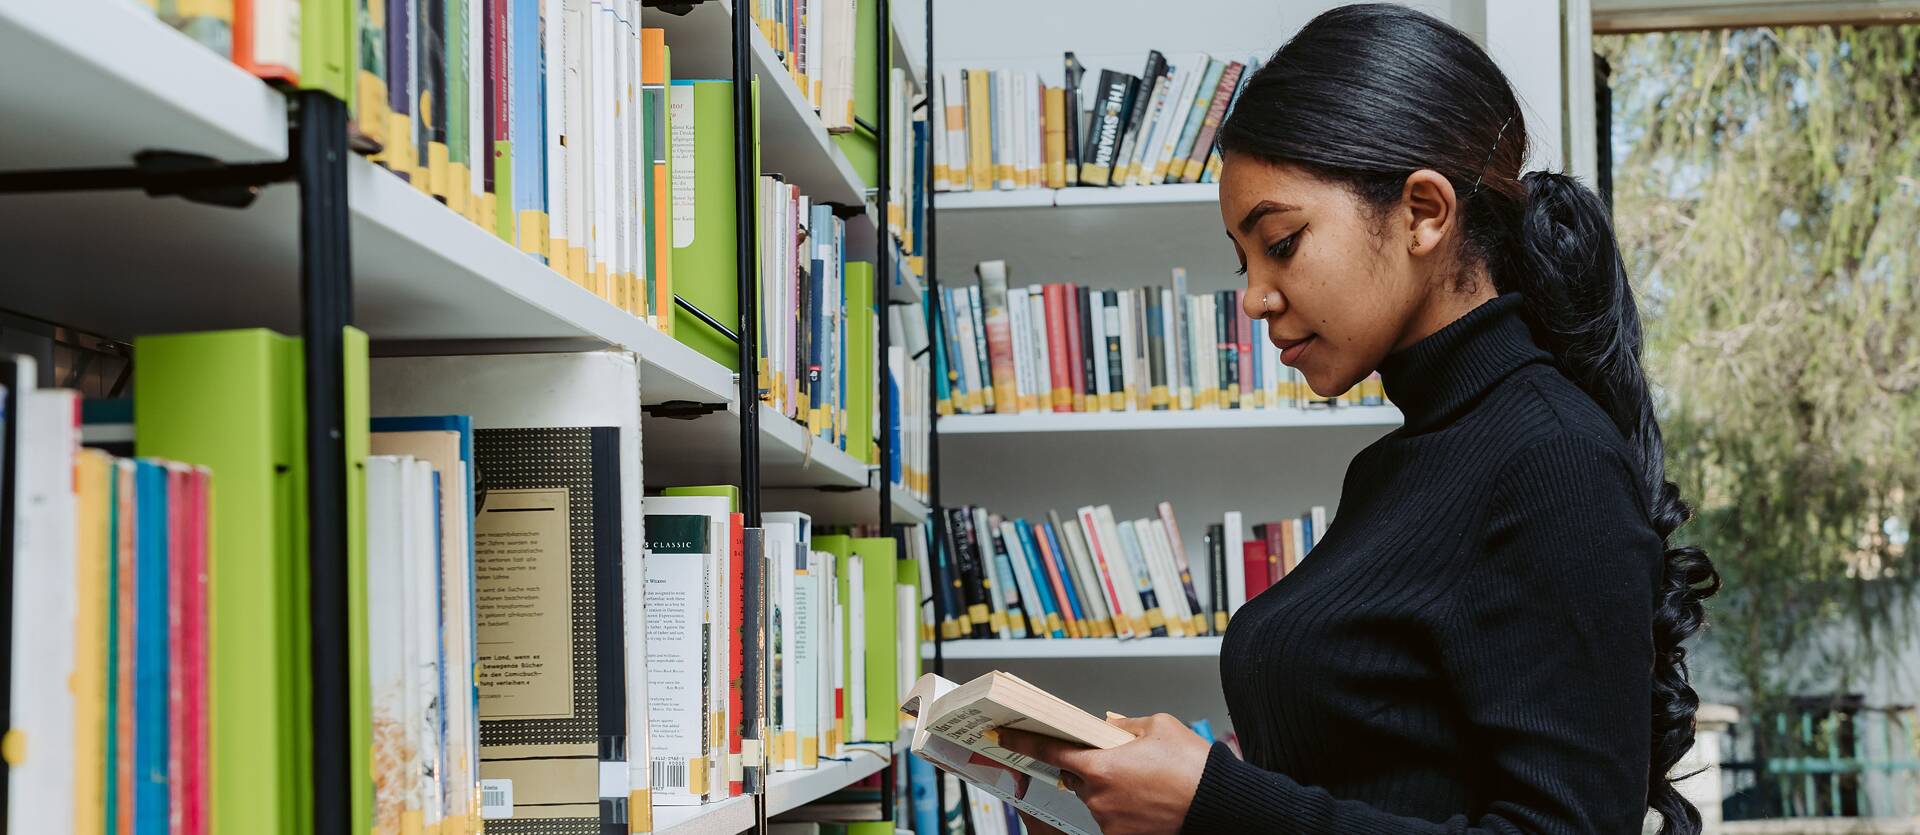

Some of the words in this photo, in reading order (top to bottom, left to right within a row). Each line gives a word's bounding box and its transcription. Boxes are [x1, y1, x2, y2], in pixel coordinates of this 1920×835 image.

[1107, 82, 1127, 113] THE
[1096, 115, 1119, 167] SWARM
[653, 541, 692, 549] CLASSIC
